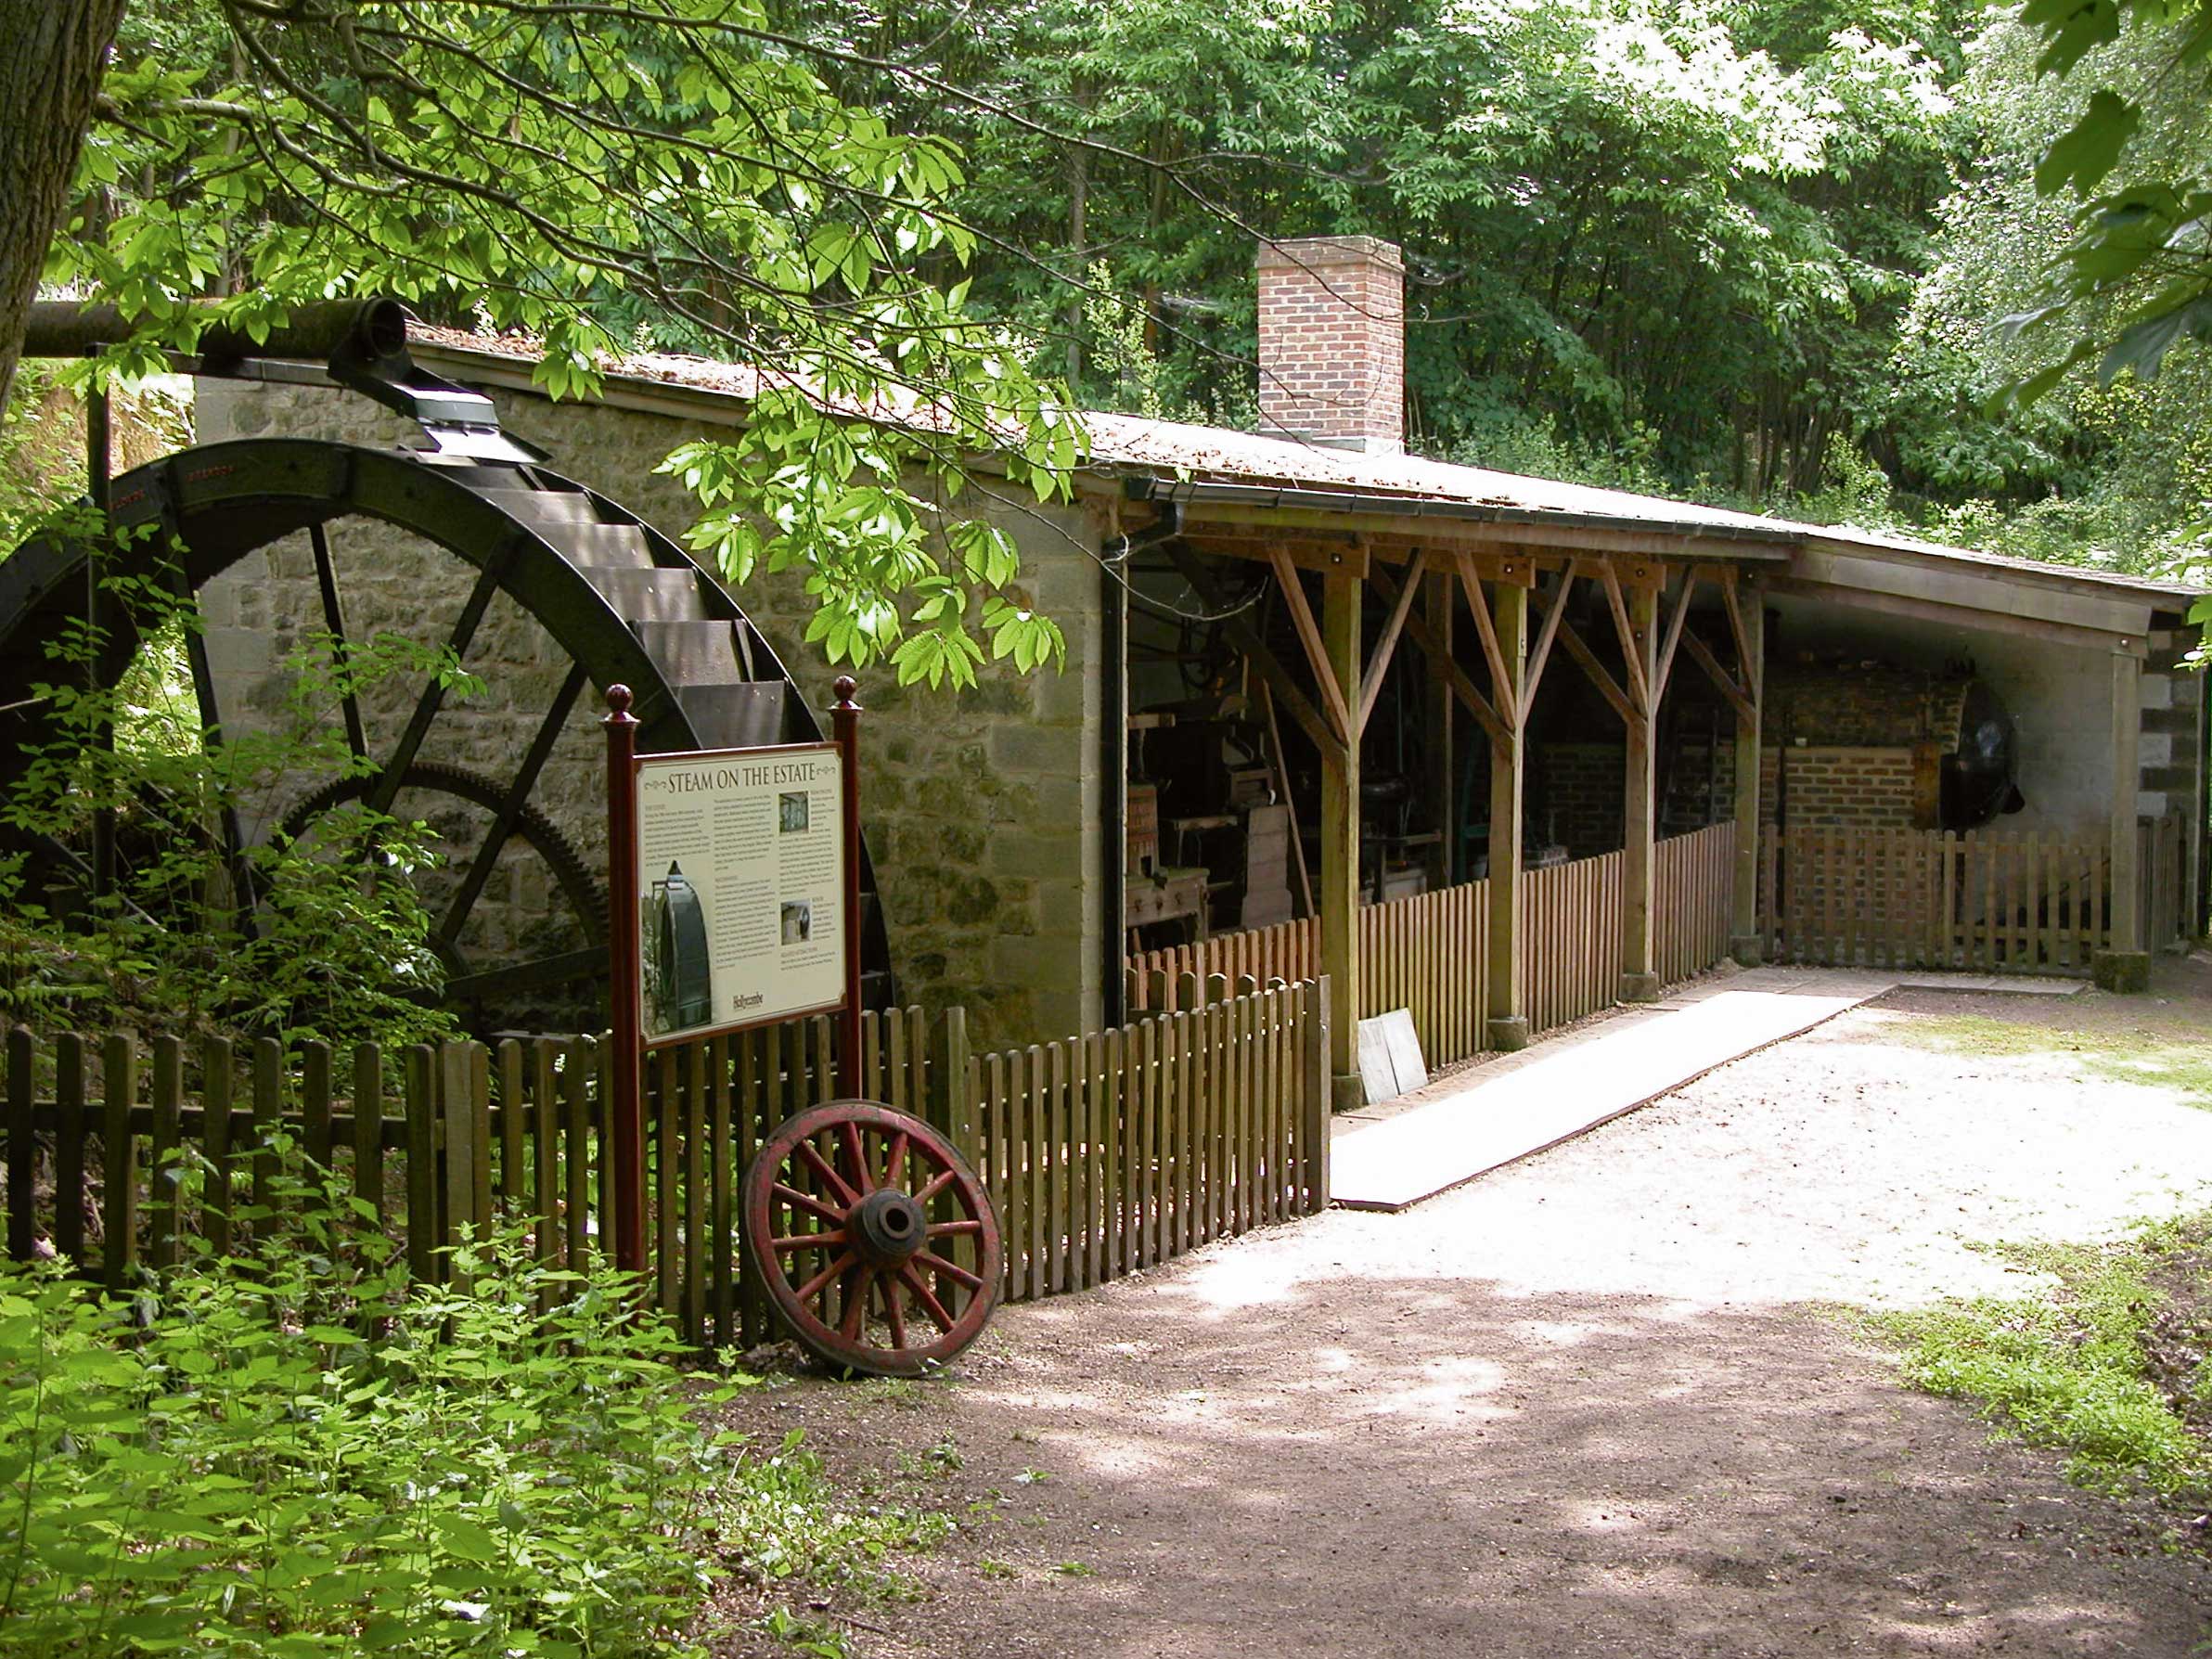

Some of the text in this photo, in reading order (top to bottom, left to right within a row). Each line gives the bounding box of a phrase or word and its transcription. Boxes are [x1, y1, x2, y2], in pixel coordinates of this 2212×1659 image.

[668, 762, 816, 793] STEAM ON THE ESTATE
